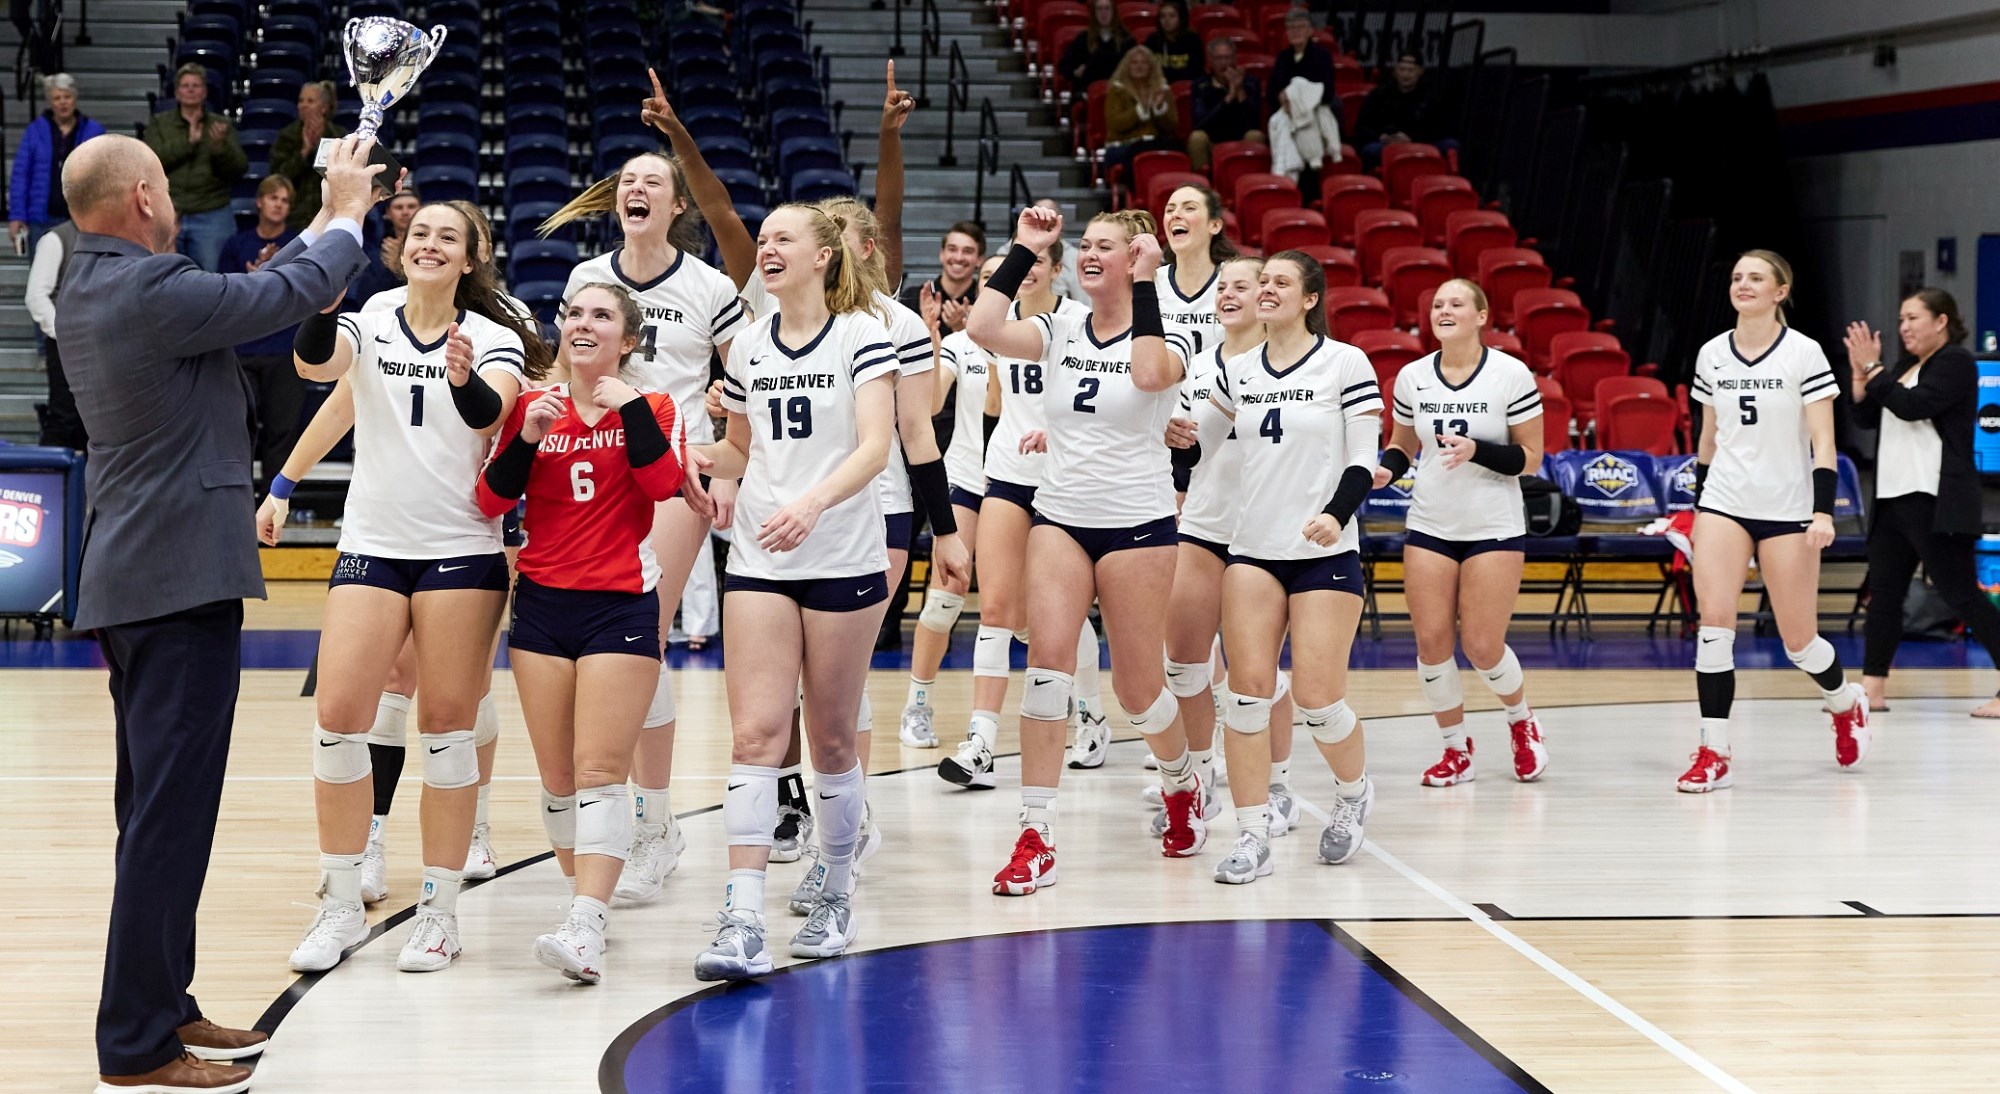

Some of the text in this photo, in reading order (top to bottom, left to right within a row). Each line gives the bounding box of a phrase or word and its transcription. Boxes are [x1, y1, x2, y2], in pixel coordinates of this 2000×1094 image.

[640, 307, 683, 324] NVER
[1175, 313, 1221, 324] DENVER
[378, 356, 447, 379] MSU DENV
[966, 364, 986, 374] MSU
[1060, 355, 1131, 374] MSU DENVER
[751, 373, 835, 393] MSU DENVER
[1009, 364, 1043, 394] 18
[1717, 378, 1783, 390] MSU DENVER
[1073, 377, 1100, 414] 2
[1241, 389, 1314, 406] MSU DENVER
[410, 384, 424, 427] 1
[1419, 402, 1488, 413] MSU DENVER
[1739, 395, 1758, 425] 5
[768, 395, 812, 441] 19
[1260, 408, 1283, 444] 4
[538, 428, 625, 453] MSU DENVE
[570, 461, 595, 502] 6
[1588, 467, 1634, 482] RMAC
[2, 489, 42, 505] DENVER
[339, 558, 369, 570] MSU
